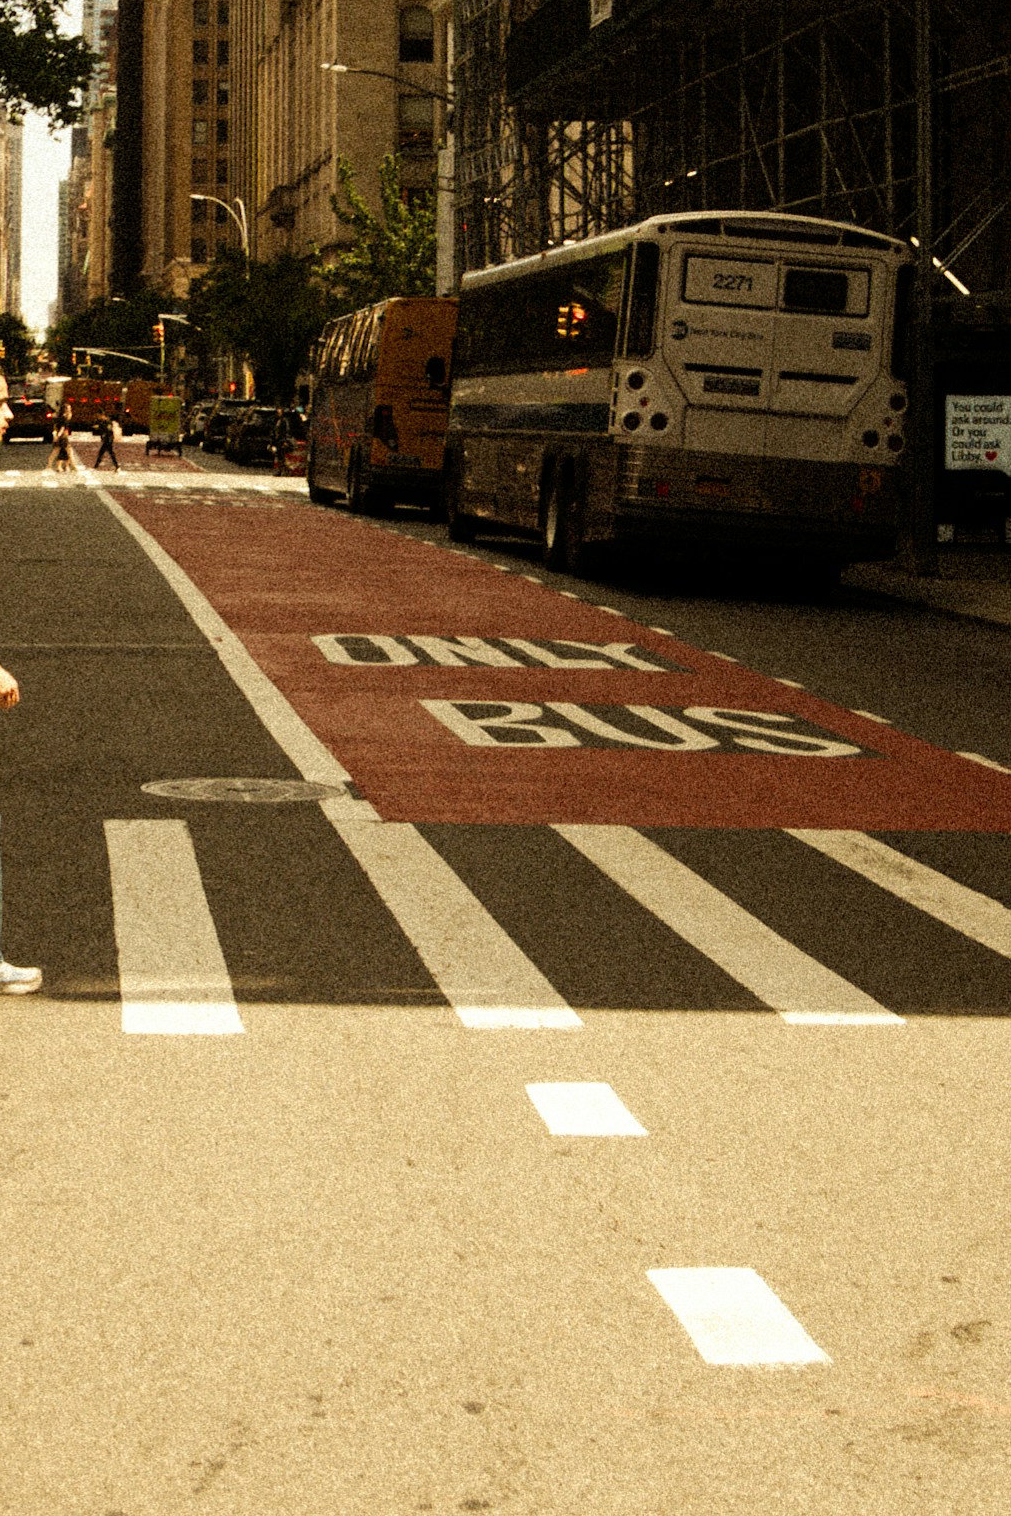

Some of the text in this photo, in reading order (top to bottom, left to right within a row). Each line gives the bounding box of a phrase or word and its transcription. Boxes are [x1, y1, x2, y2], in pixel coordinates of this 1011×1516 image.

[712, 273, 753, 292] 2271
[952, 401, 1004, 412] You could
[952, 414, 970, 424] ask
[952, 426, 987, 439] Or you
[952, 439, 1001, 449] could ask
[310, 634, 666, 672] ONLY
[418, 699, 861, 757] BUS
